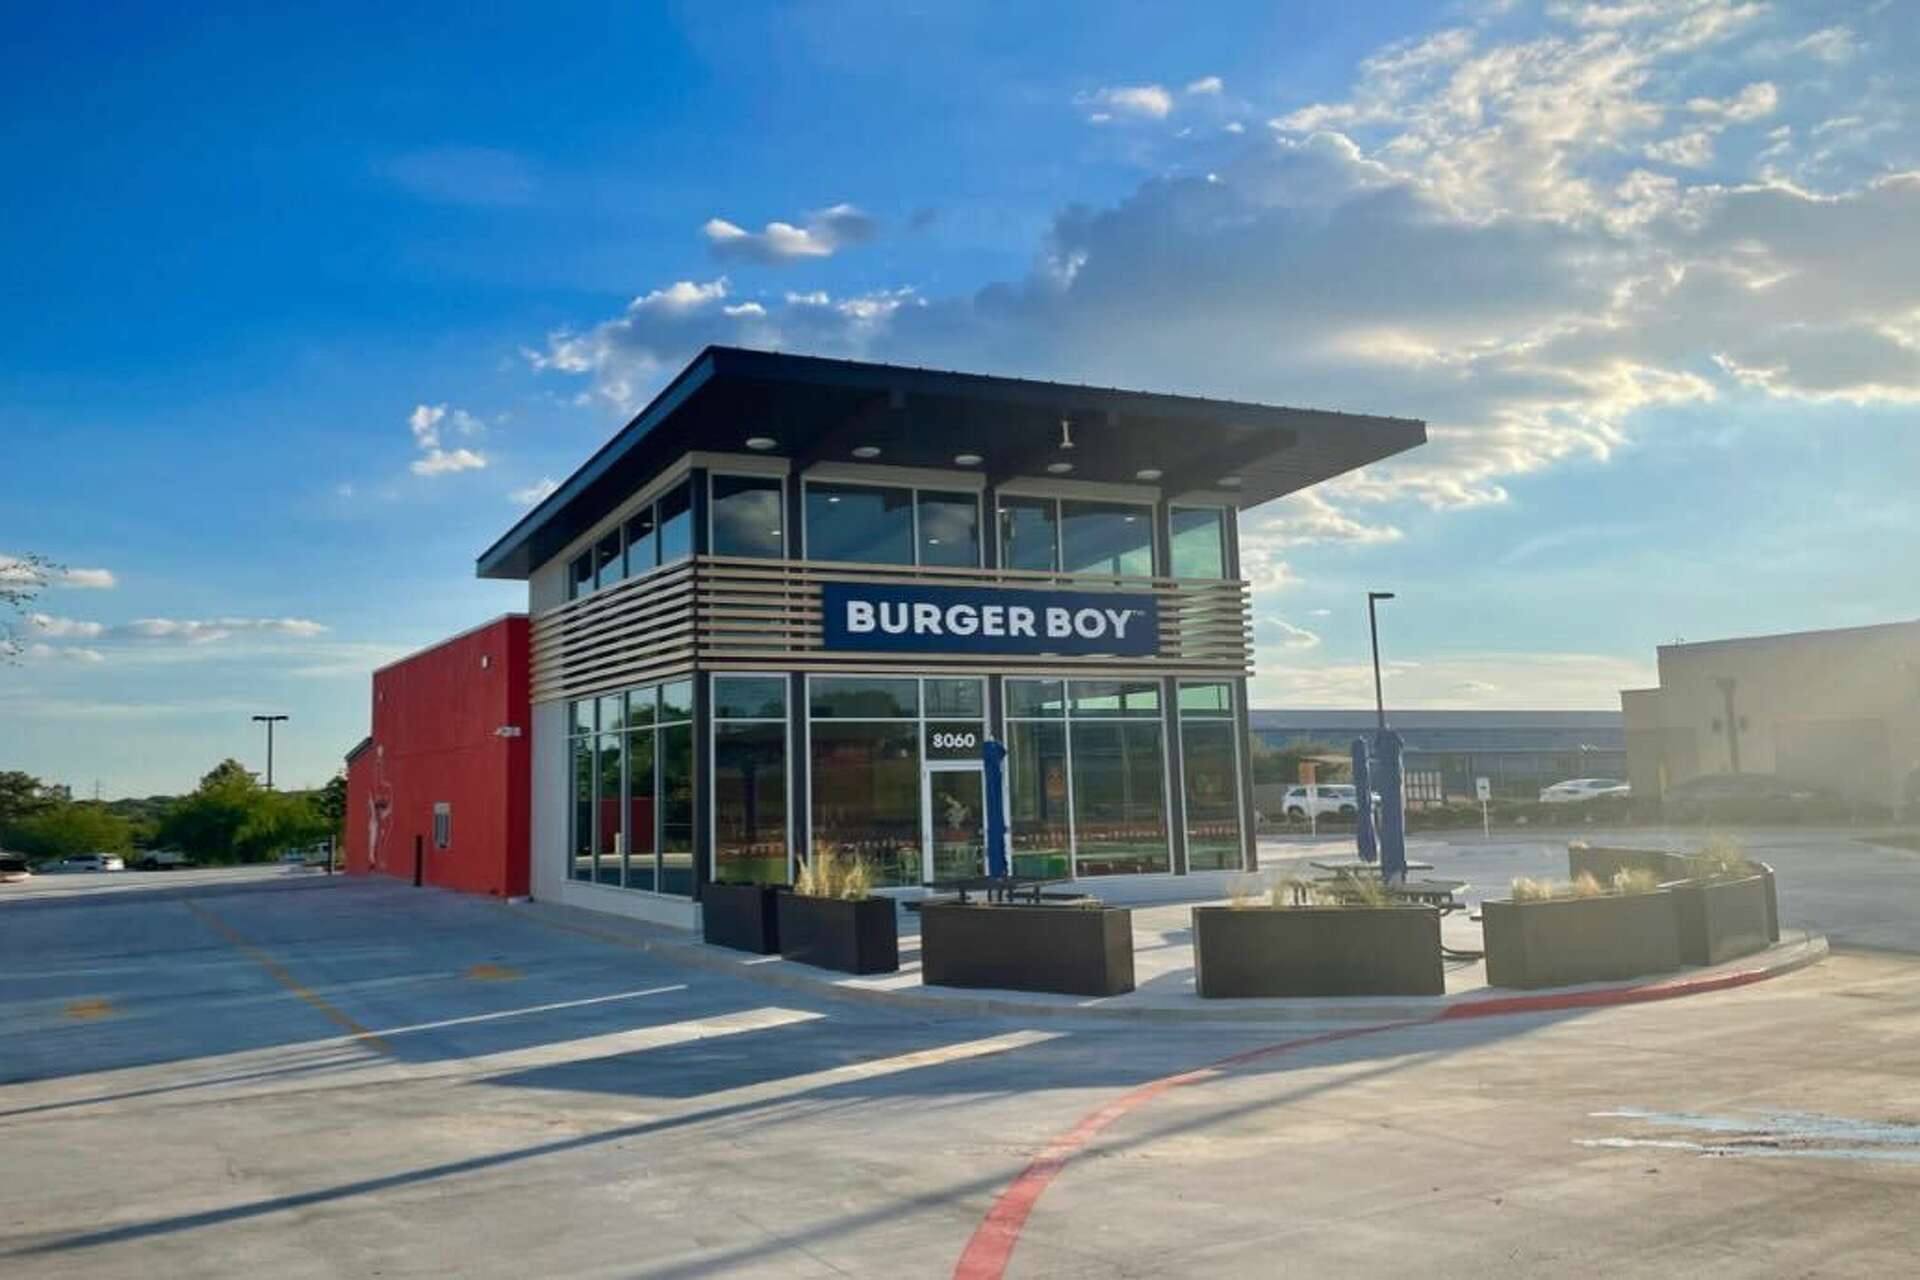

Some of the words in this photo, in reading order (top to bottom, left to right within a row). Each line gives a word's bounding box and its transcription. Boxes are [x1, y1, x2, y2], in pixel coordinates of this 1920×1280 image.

[847, 600, 1036, 637] BURGER
[1047, 608, 1131, 639] BOY
[932, 733, 976, 748] 8060
